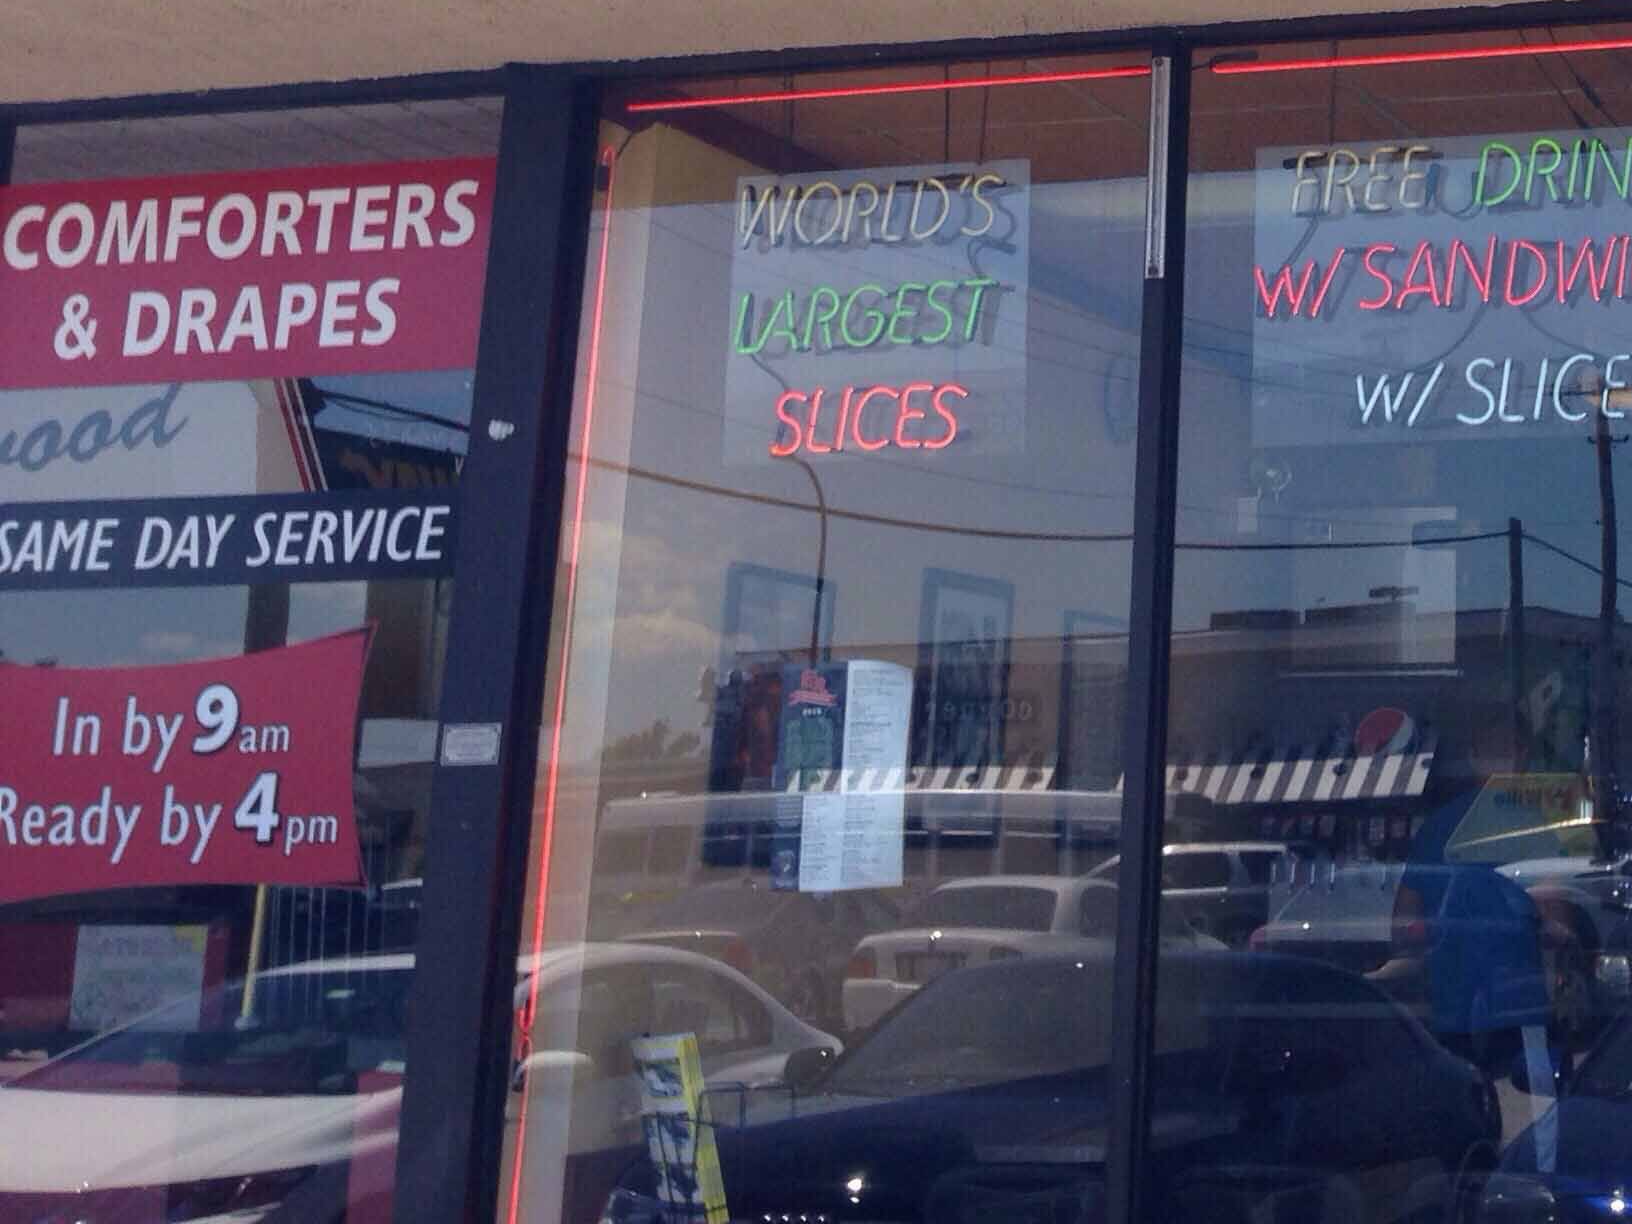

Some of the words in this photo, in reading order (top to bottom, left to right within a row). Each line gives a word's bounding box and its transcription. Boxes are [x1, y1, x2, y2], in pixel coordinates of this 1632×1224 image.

[738, 175, 1008, 249] WORLD'S
[1290, 145, 1435, 214] FREE
[3, 179, 480, 271] COMFORTERS
[53, 295, 98, 360] &
[123, 279, 401, 358] DRAPES
[733, 276, 1000, 355] LARGEST
[769, 384, 968, 457] SLICES
[0, 518, 119, 573] SAME
[135, 514, 236, 569] DAY
[246, 506, 450, 564] SERVICE
[52, 698, 102, 756] In
[123, 699, 183, 772] by
[0, 787, 141, 864] Ready
[160, 787, 222, 864] by
